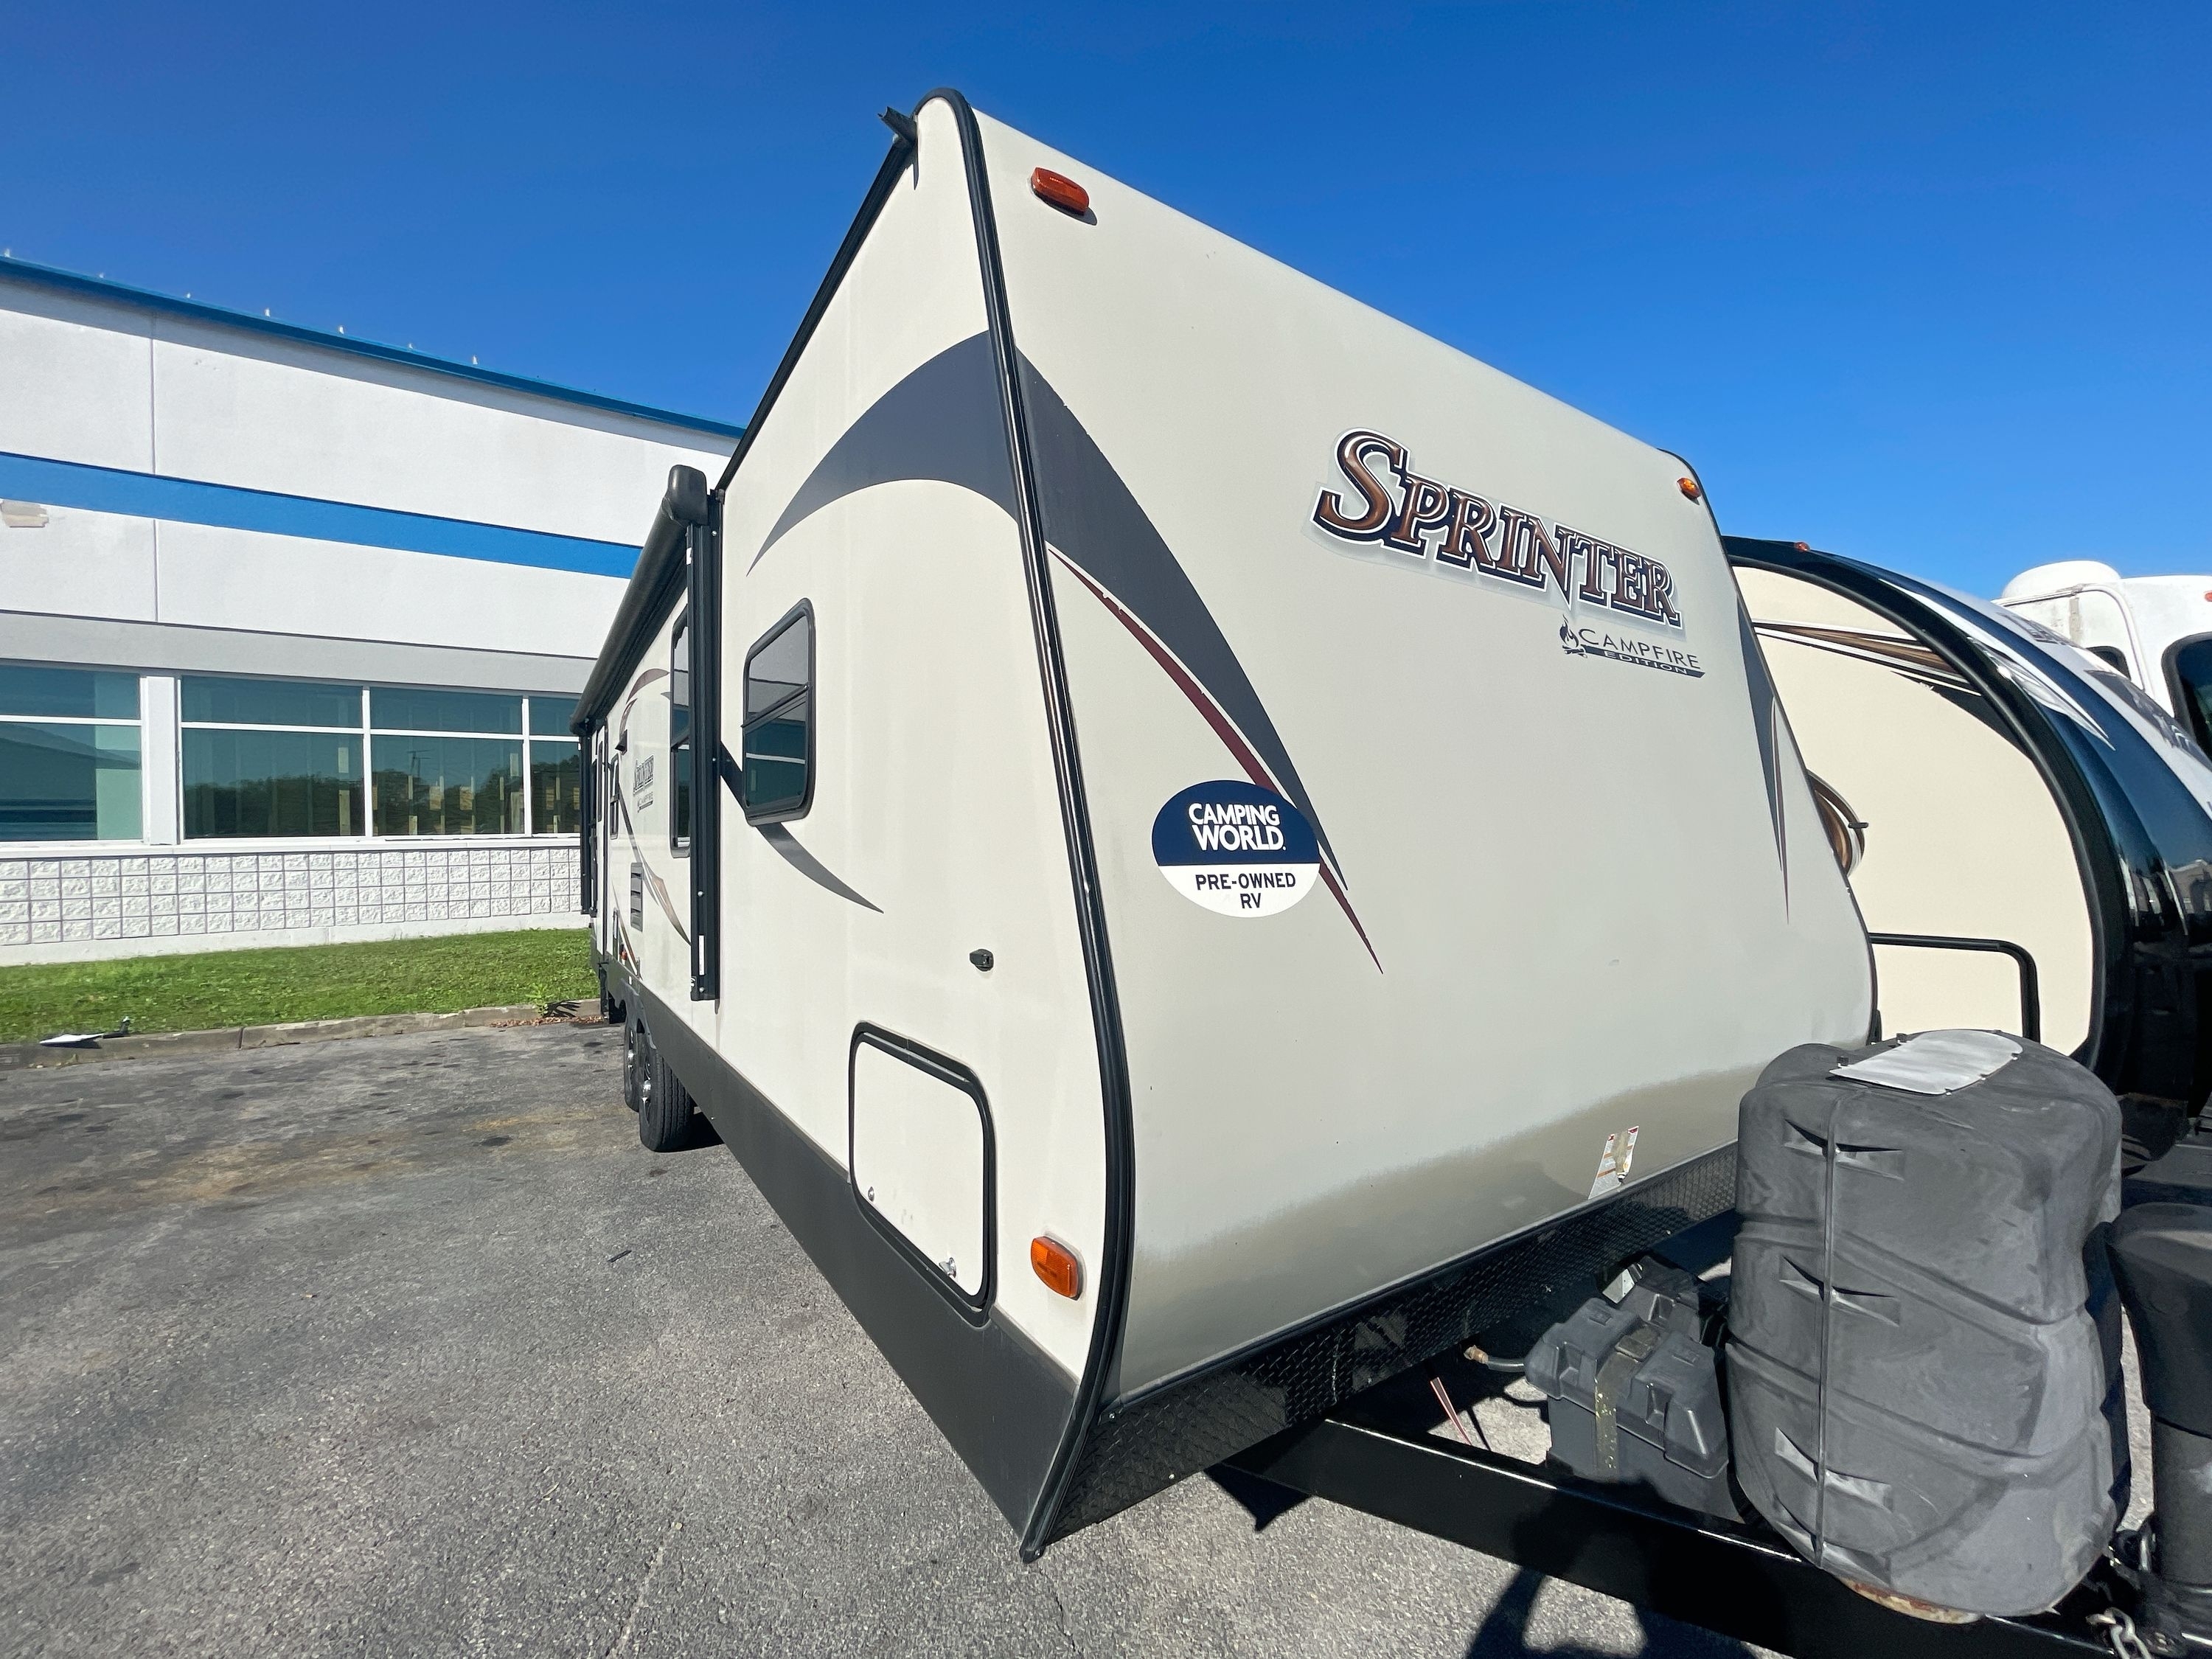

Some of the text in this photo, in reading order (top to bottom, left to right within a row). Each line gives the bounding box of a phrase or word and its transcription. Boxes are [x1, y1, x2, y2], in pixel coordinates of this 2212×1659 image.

[1312, 428, 1683, 629] SPRINTER
[1578, 628, 1701, 669] CAMPFIRE
[1604, 650, 1687, 675] EDITION
[1188, 802, 1280, 826] CAMPING
[1195, 872, 1296, 891] PRE-OWNED
[1240, 893, 1262, 909] RV
